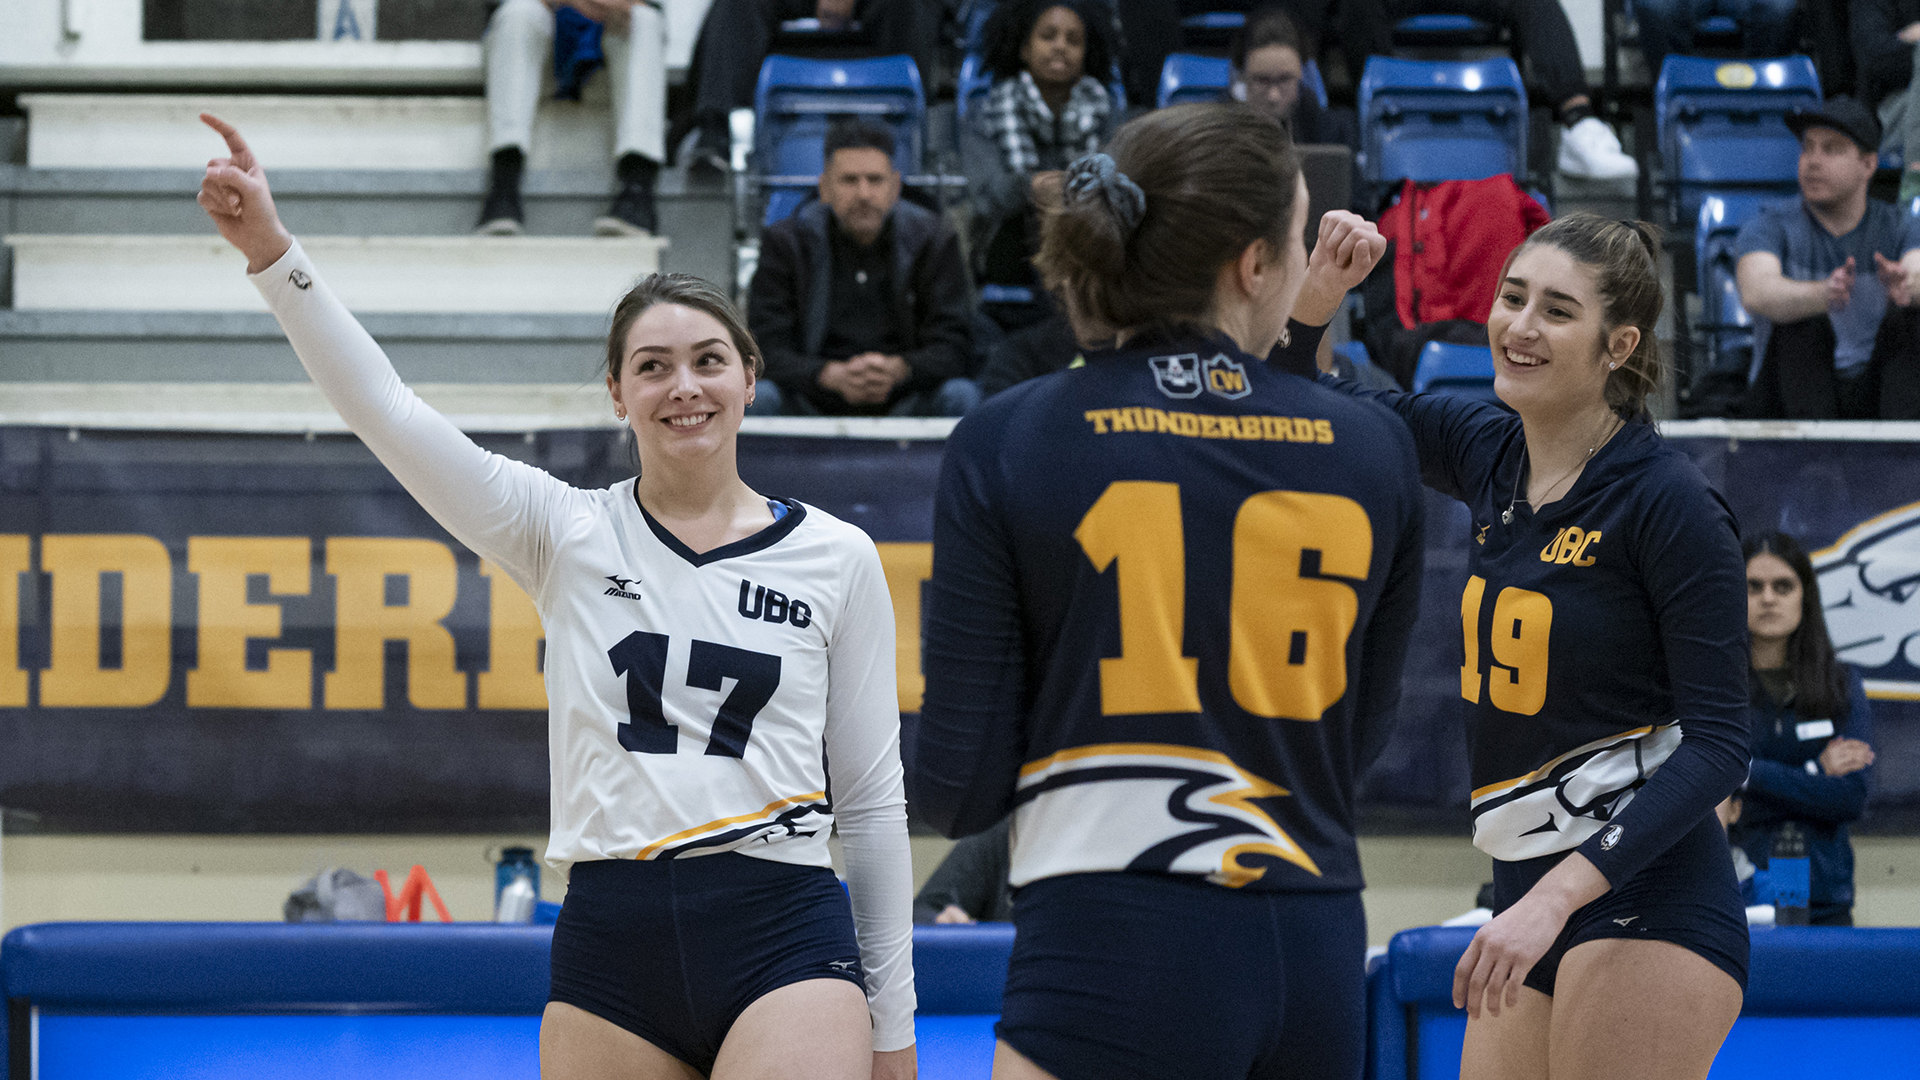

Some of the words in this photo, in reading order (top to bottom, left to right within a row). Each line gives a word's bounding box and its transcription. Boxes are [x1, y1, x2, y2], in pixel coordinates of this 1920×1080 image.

[1085, 407, 1334, 443] THUNDERBIRDS
[1073, 480, 1374, 721] 16
[1540, 526, 1602, 567] UBC
[0, 534, 550, 710] DER
[1460, 574, 1553, 716] 19
[607, 630, 782, 760] 17
